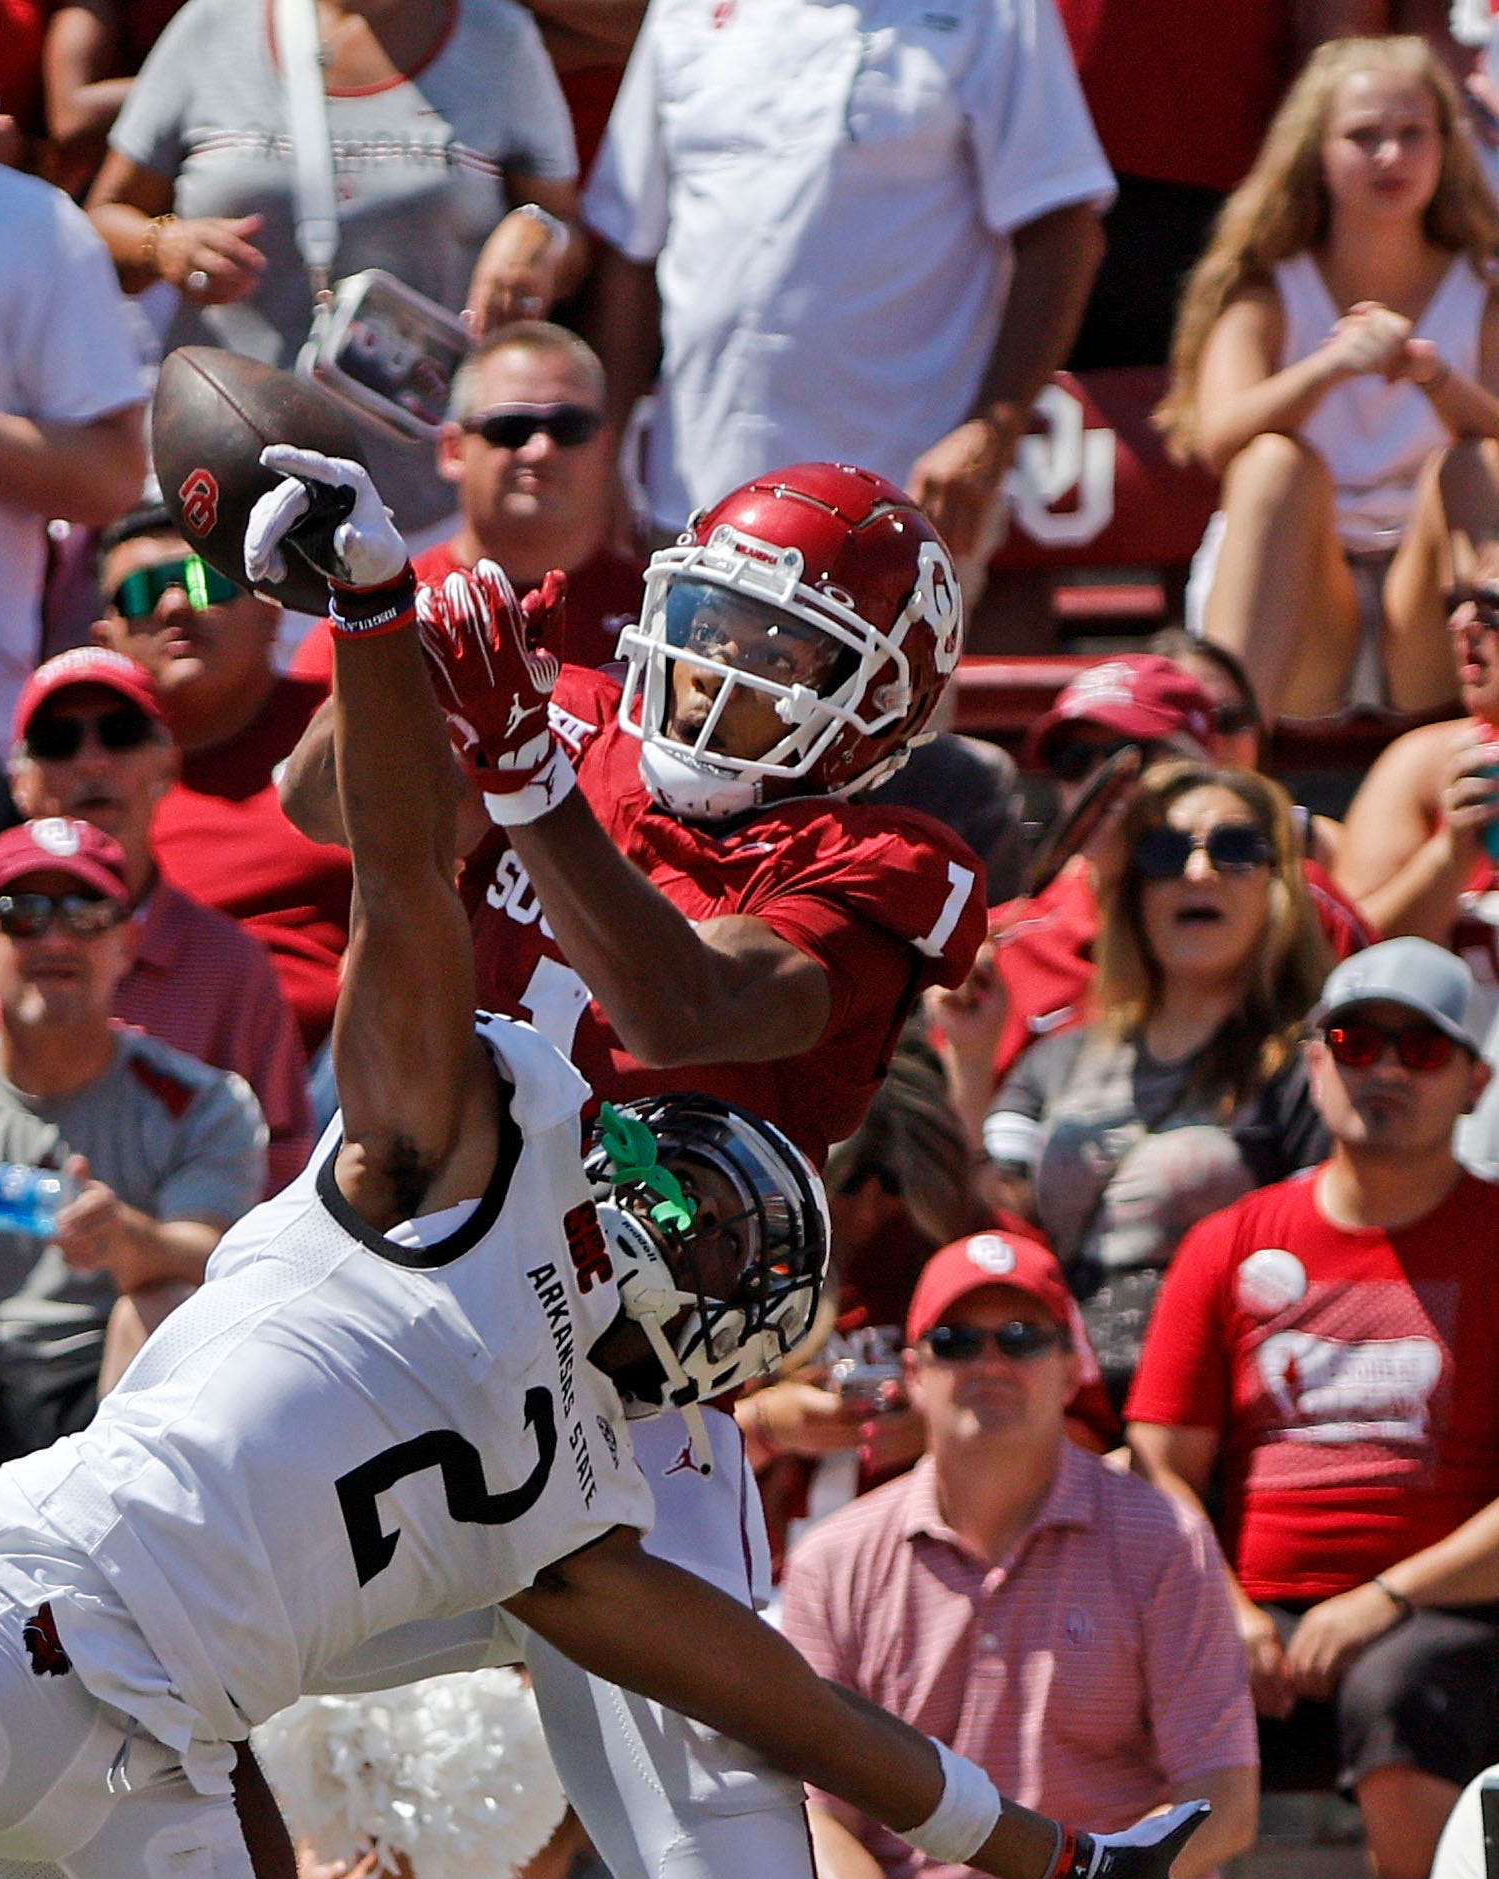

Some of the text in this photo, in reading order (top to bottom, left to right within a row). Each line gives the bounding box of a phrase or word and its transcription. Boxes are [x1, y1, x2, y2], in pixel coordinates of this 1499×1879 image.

[179, 467, 220, 537] OU
[909, 860, 976, 958] 1
[526, 1262, 598, 1511] ARKANSAS STATE
[334, 1385, 558, 1588] 2
